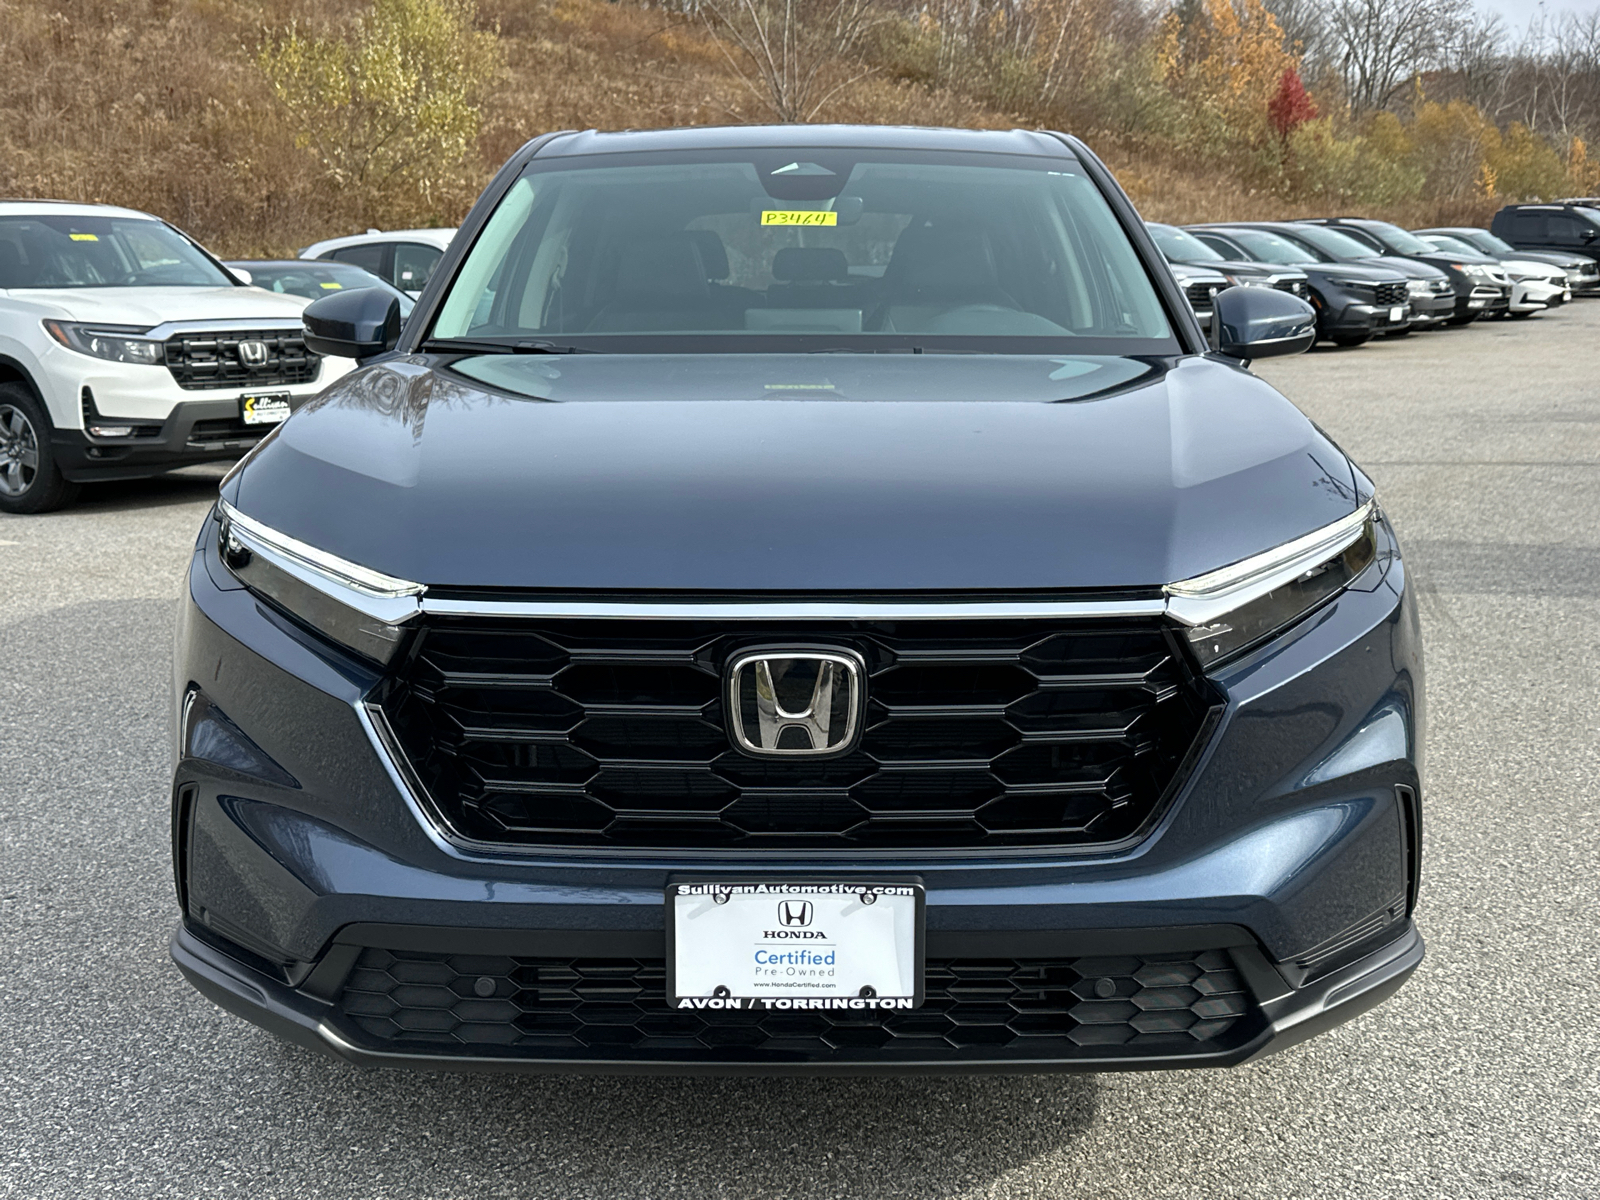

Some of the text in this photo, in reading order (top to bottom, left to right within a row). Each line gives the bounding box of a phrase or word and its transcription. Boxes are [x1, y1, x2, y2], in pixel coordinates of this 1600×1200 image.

[766, 213, 827, 225] P3464
[677, 884, 915, 896] SullivanAutomotive.com
[762, 930, 828, 940] HONDA
[754, 949, 835, 965] Certified
[755, 966, 835, 977] Pre-Owned
[753, 981, 837, 989] www.HondaCertified.com
[677, 998, 742, 1010] AVON
[760, 998, 914, 1010] TORRINGTON
